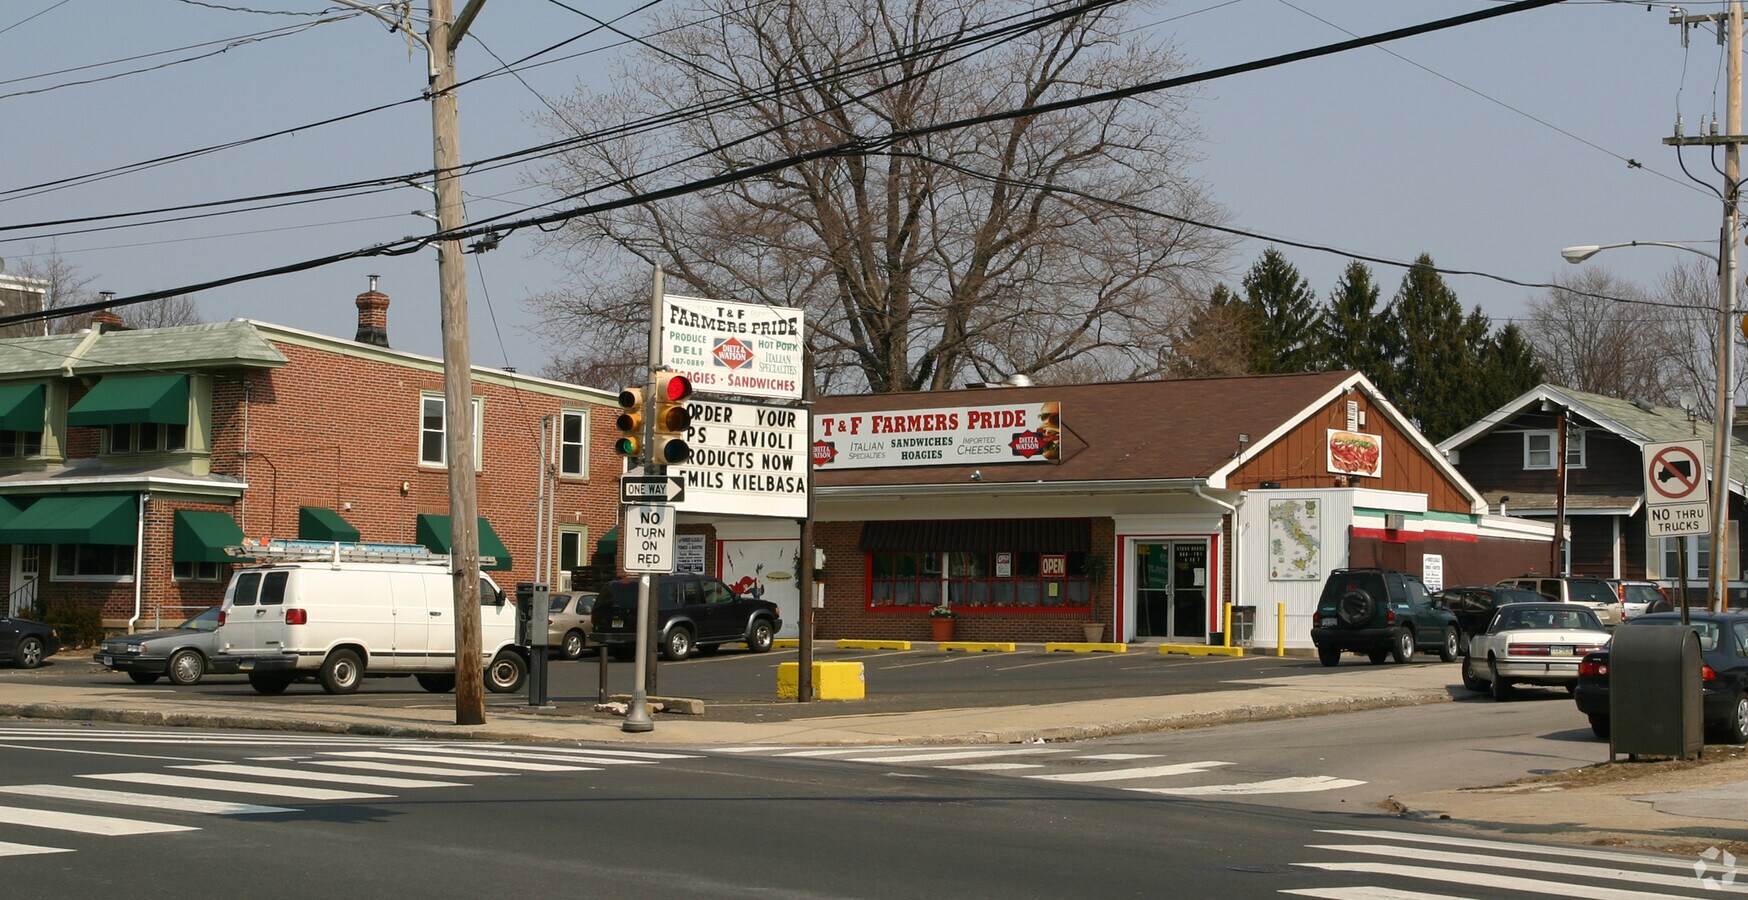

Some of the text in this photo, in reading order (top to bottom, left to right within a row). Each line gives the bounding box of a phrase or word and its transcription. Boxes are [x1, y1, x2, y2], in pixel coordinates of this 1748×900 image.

[717, 307, 745, 319] T & F
[670, 305, 797, 336] FARMERS PRIDE
[670, 331, 707, 344] PRODUCE
[673, 344, 703, 356] DELI
[722, 344, 740, 352] DIETZ
[758, 340, 798, 352] HOT PORK
[718, 351, 747, 361] WATSON
[765, 352, 791, 364] ITALIAN
[669, 368, 796, 392] AGIES SANDWICHES
[686, 403, 796, 428] ORDER YOUR
[822, 410, 1027, 437] T & F FARMERS PRIDE
[728, 429, 793, 449] RAVIOLI
[890, 436, 954, 448] SANDWICHES
[962, 436, 996, 444] IMPORTED
[850, 442, 884, 451] ITALIAN
[957, 444, 1002, 455] CHEESES
[686, 448, 794, 471] RODUCTS NOW
[848, 451, 886, 460] SPECIALTIES
[901, 449, 943, 461] HOAGIES
[628, 483, 667, 495] ONE WAY
[732, 473, 805, 494] KIELBASA
[640, 512, 661, 525] NO
[1652, 508, 1704, 521] NO THRU
[635, 527, 666, 538] TURN
[1658, 521, 1699, 532] TRUCKS
[641, 541, 657, 551] ON
[637, 554, 661, 564] RED
[1042, 558, 1065, 574] OPEN
